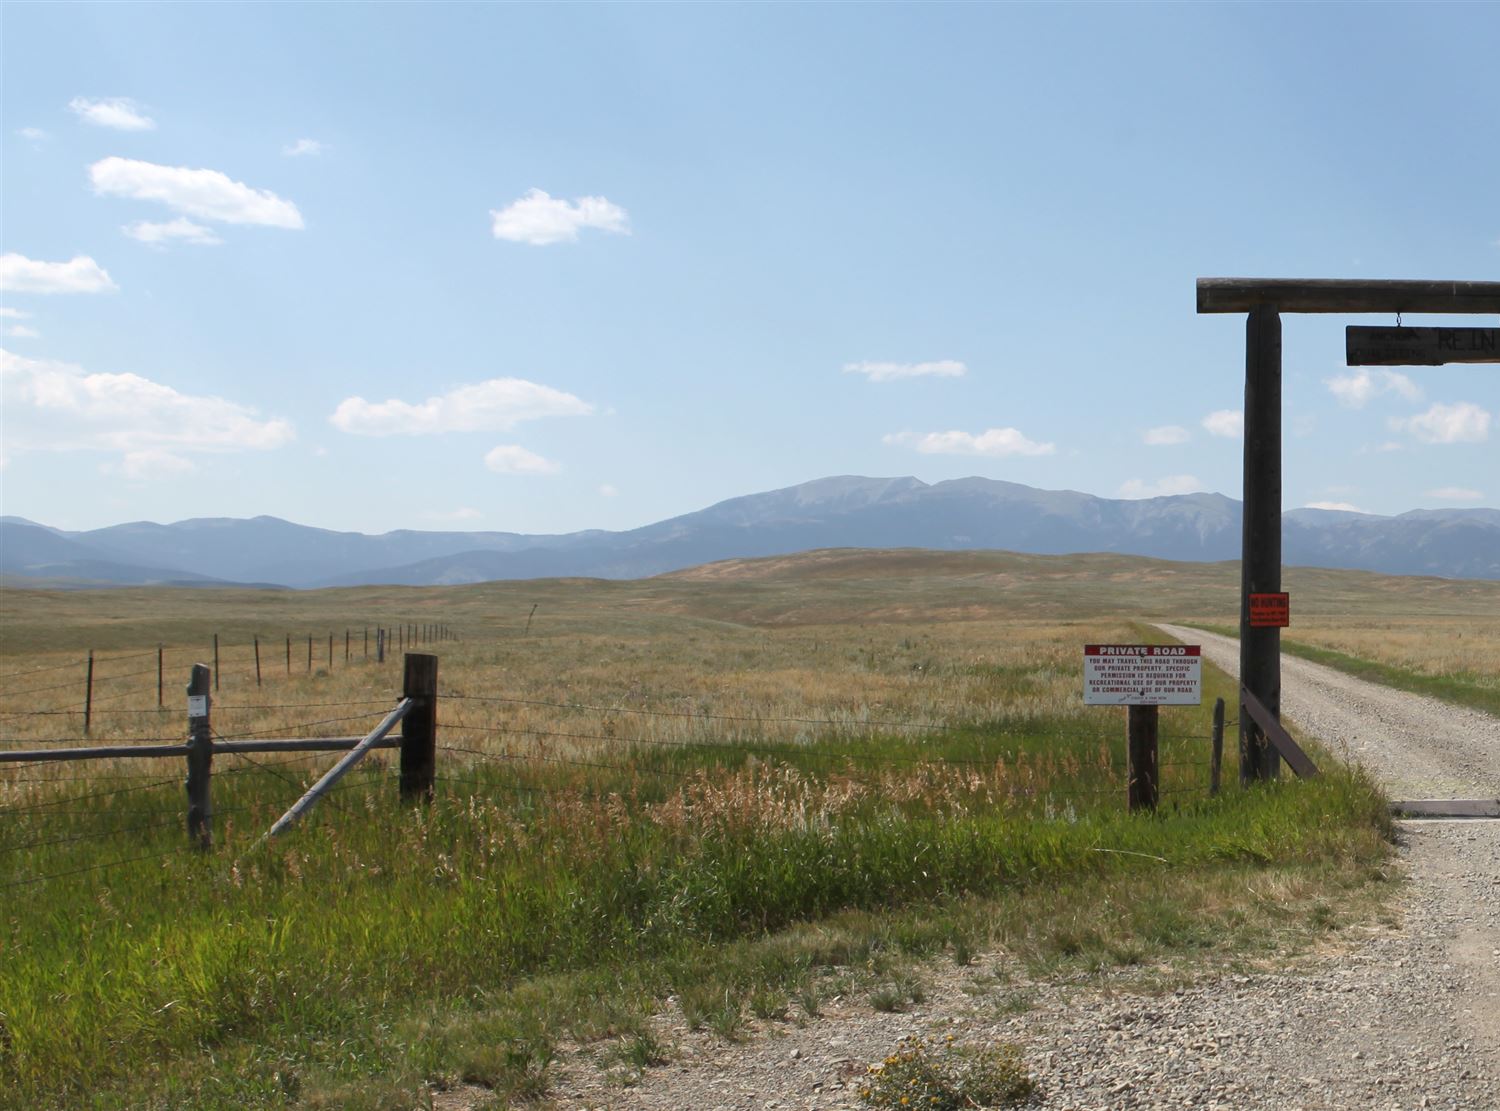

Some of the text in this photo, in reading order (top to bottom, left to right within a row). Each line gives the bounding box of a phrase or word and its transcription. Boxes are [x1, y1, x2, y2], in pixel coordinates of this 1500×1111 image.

[1438, 329, 1496, 351] REIN
[1100, 647, 1186, 655] PRIVATE ROAD
